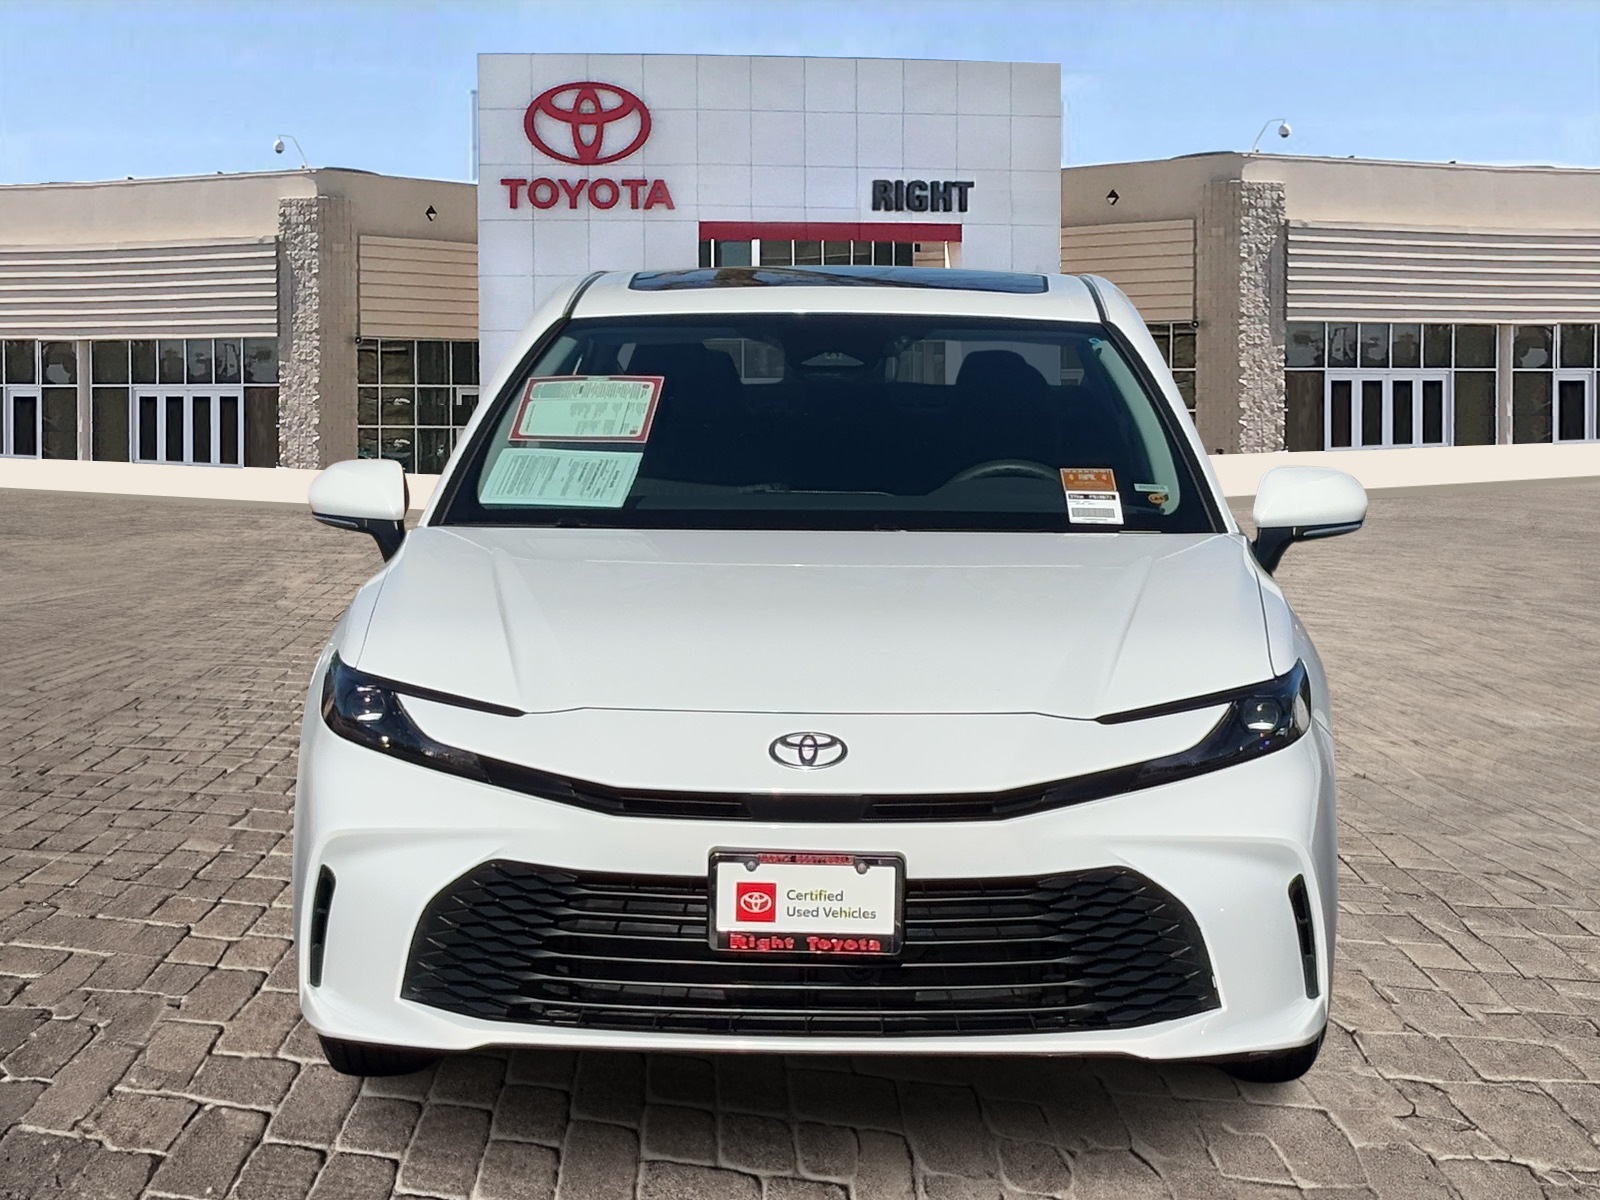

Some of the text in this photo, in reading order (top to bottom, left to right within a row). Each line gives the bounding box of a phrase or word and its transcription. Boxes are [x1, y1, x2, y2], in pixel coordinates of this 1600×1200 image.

[500, 179, 675, 210] TOYOTA
[872, 179, 975, 212] RIGHT
[786, 889, 844, 903] Certified
[786, 906, 877, 920] Used Vehicles
[729, 933, 881, 953] Right Toyota
